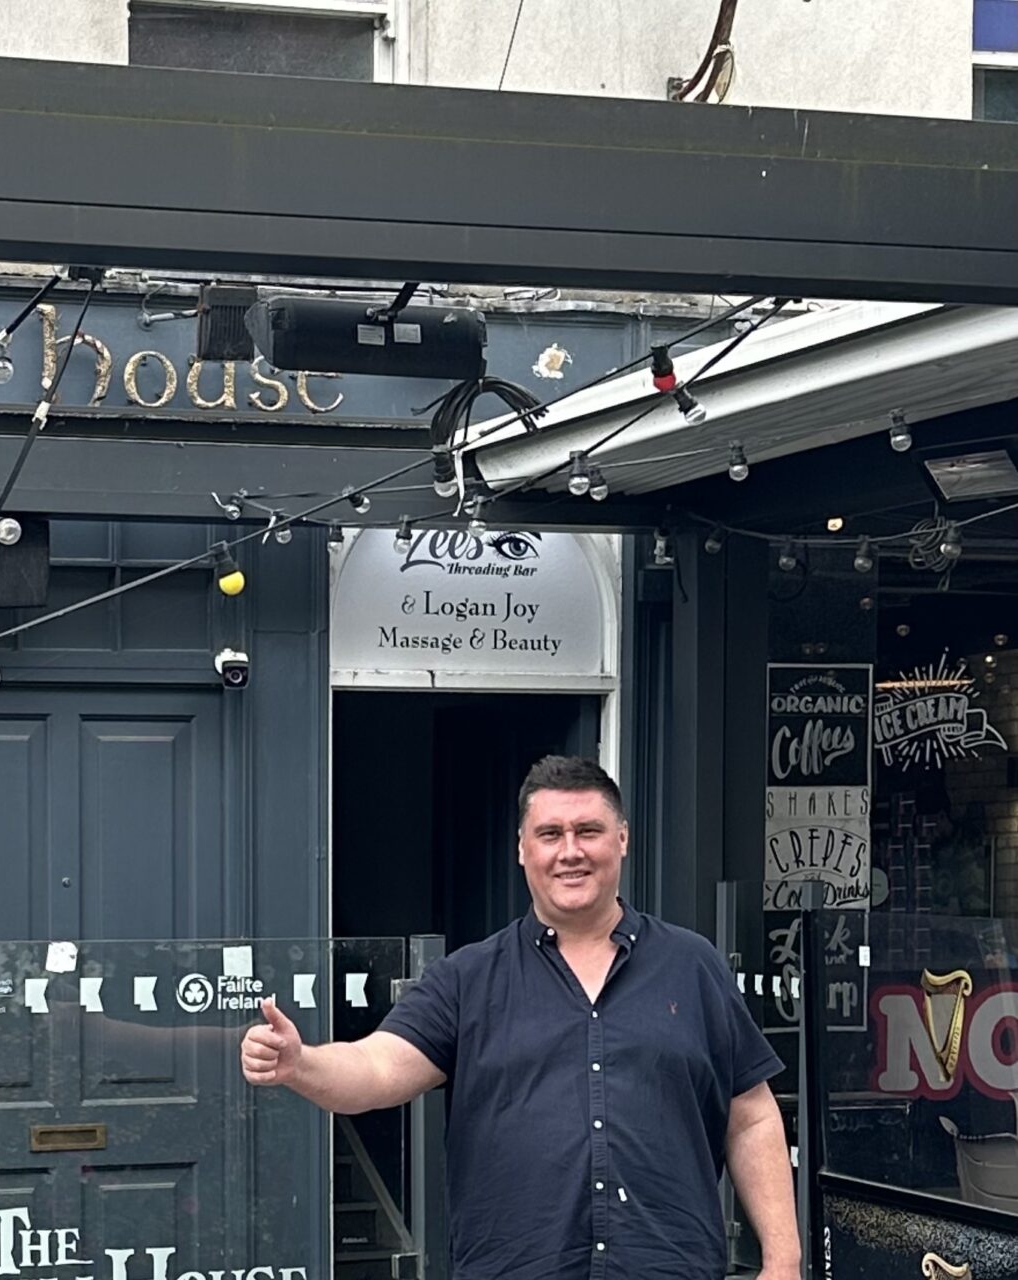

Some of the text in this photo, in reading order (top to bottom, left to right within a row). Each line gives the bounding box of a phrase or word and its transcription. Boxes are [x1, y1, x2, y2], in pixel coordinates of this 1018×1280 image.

[447, 562, 538, 579] Threading Bar
[401, 590, 540, 623] & Logan Joy
[378, 626, 562, 656] Massage & Beauty
[771, 695, 865, 714] ORGANIC
[874, 710, 905, 743] ICE
[905, 696, 965, 731] CREAM
[772, 719, 856, 779] Coffees
[766, 788, 869, 818] SHAKES
[823, 879, 870, 906] Drinks
